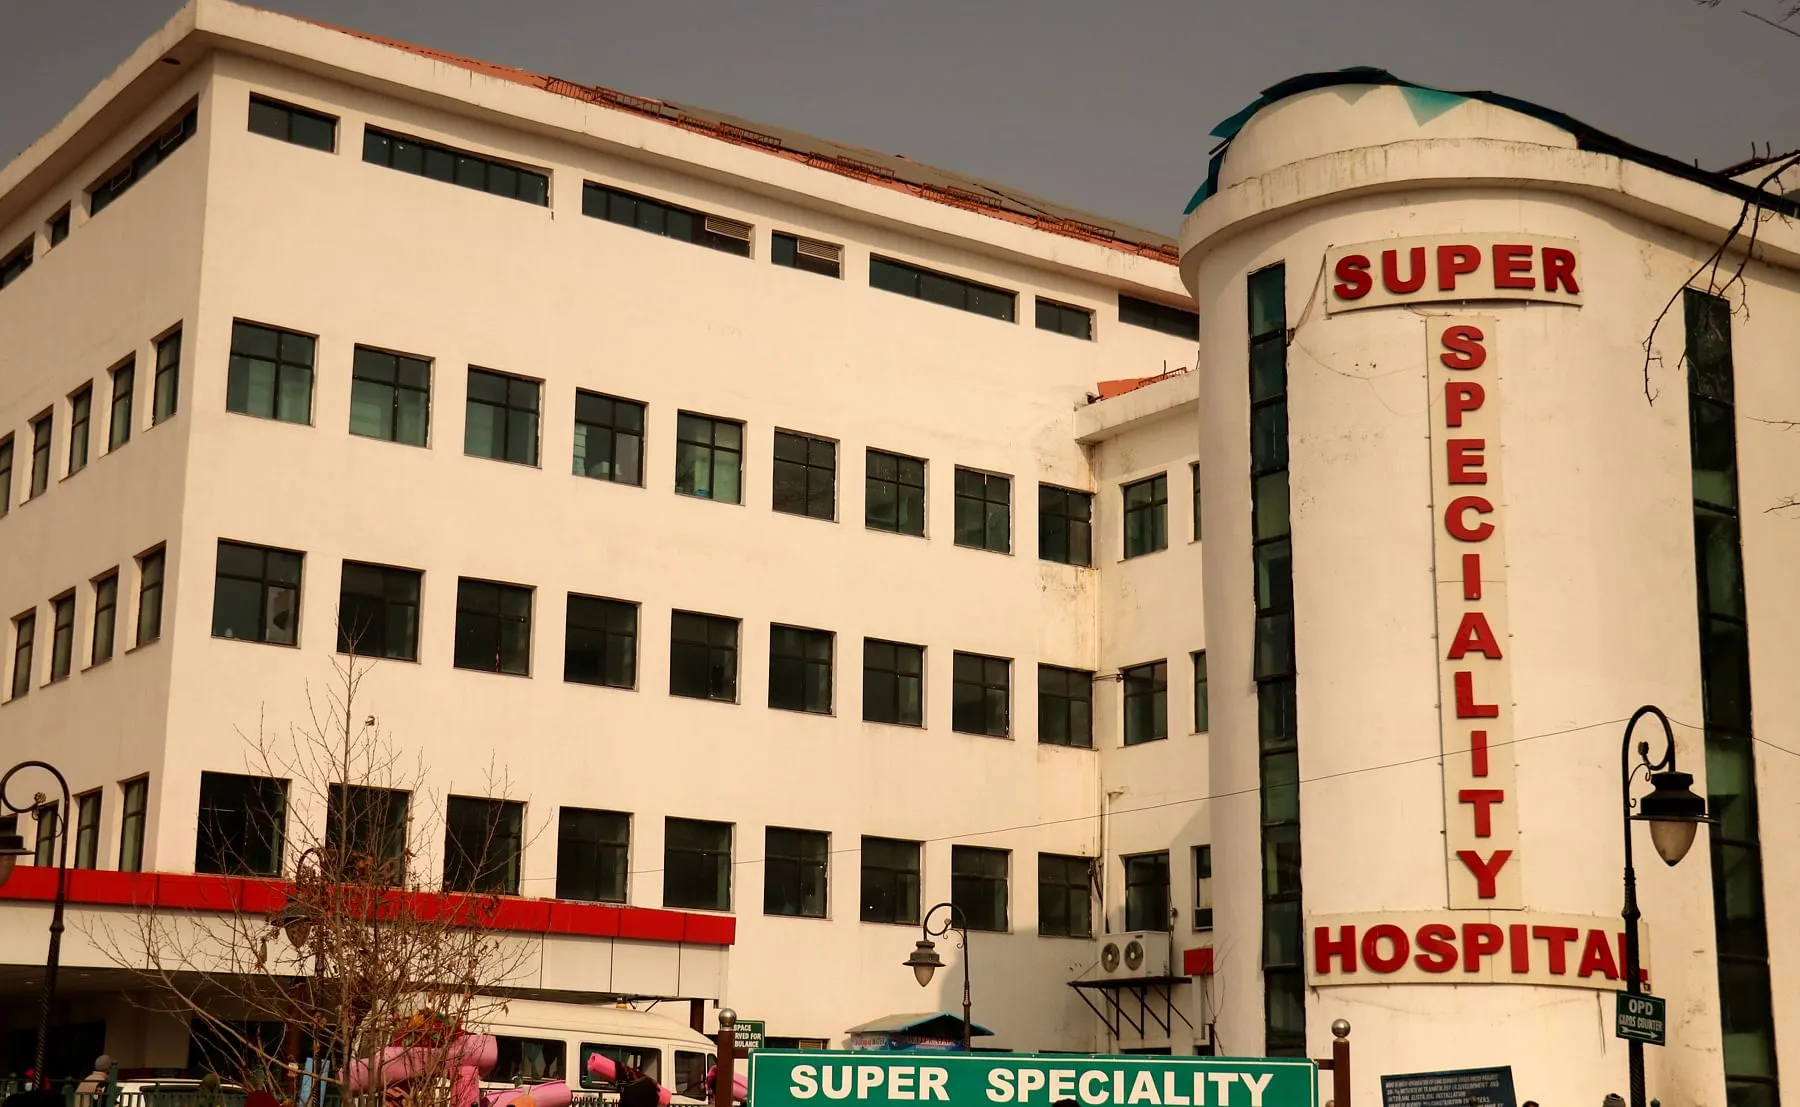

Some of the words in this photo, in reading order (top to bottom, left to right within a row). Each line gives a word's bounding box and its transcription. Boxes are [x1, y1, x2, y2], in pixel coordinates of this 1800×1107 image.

[1333, 244, 1581, 300] SUPER
[1440, 325, 1512, 900] SPECIALITY
[1314, 923, 1648, 981] HOSPITAL
[733, 1024, 752, 1032] SPACE
[1628, 998, 1654, 1016] OPD
[1637, 1016, 1664, 1031] COUNTER
[789, 1064, 950, 1100] SUPER
[985, 1068, 1274, 1107] SPECIALITY
